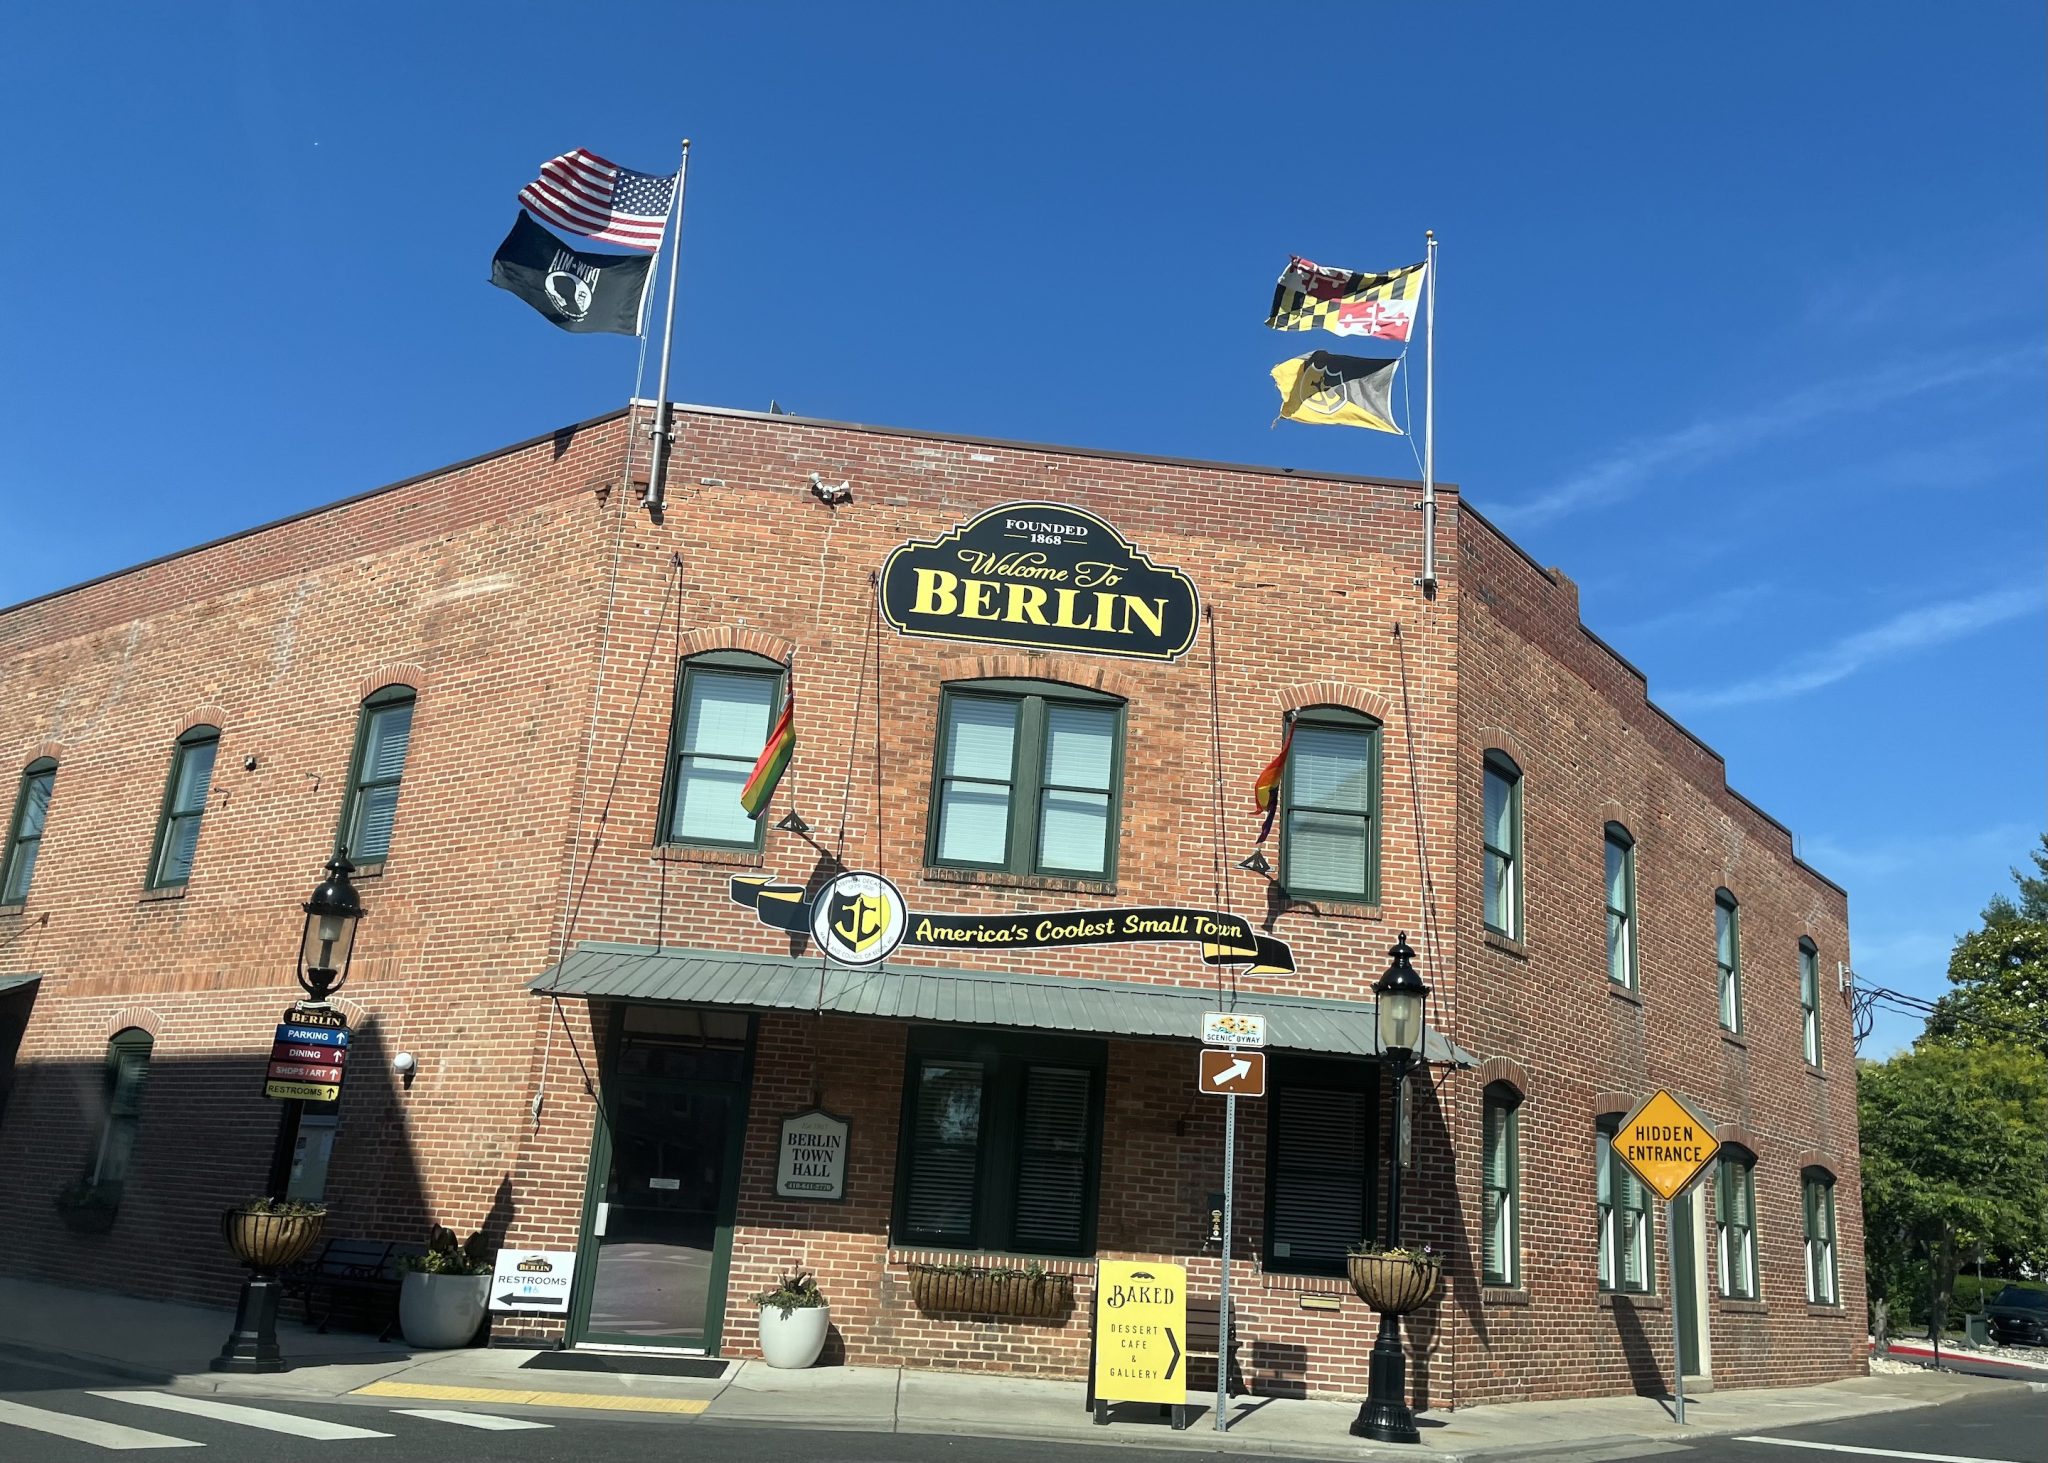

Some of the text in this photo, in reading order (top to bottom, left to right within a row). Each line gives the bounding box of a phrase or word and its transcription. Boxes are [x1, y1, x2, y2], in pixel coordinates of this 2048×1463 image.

[1006, 519, 1088, 536] FOUNDED
[1030, 534, 1062, 545] 1868
[957, 549, 1129, 588] Welcome To
[908, 567, 1169, 637] BERLIN
[915, 914, 1242, 943] America's Coolest Small Town
[290, 1012, 341, 1026] BERLIN
[287, 1029, 329, 1041] PARKING
[1207, 1034, 1260, 1044] SCENIC BYWAY
[289, 1049, 321, 1059] DINING
[276, 1066, 304, 1075] SHOPS
[309, 1069, 327, 1077] ART
[268, 1085, 323, 1096] RESTROOMS
[1636, 1126, 1693, 1141] HIDDEN
[788, 1133, 841, 1148] BERLIN
[792, 1148, 834, 1163] TOWN
[1628, 1146, 1702, 1162] ENTRANCE
[792, 1163, 830, 1177] HALL
[519, 1263, 550, 1271] BERLIN
[498, 1275, 567, 1286] RESTROOMS
[1107, 1285, 1174, 1308] BAKED
[1111, 1323, 1158, 1335] DESSERT
[1121, 1339, 1147, 1349] CAFE
[1131, 1355, 1136, 1363] &
[1110, 1367, 1157, 1379] GALLERY
